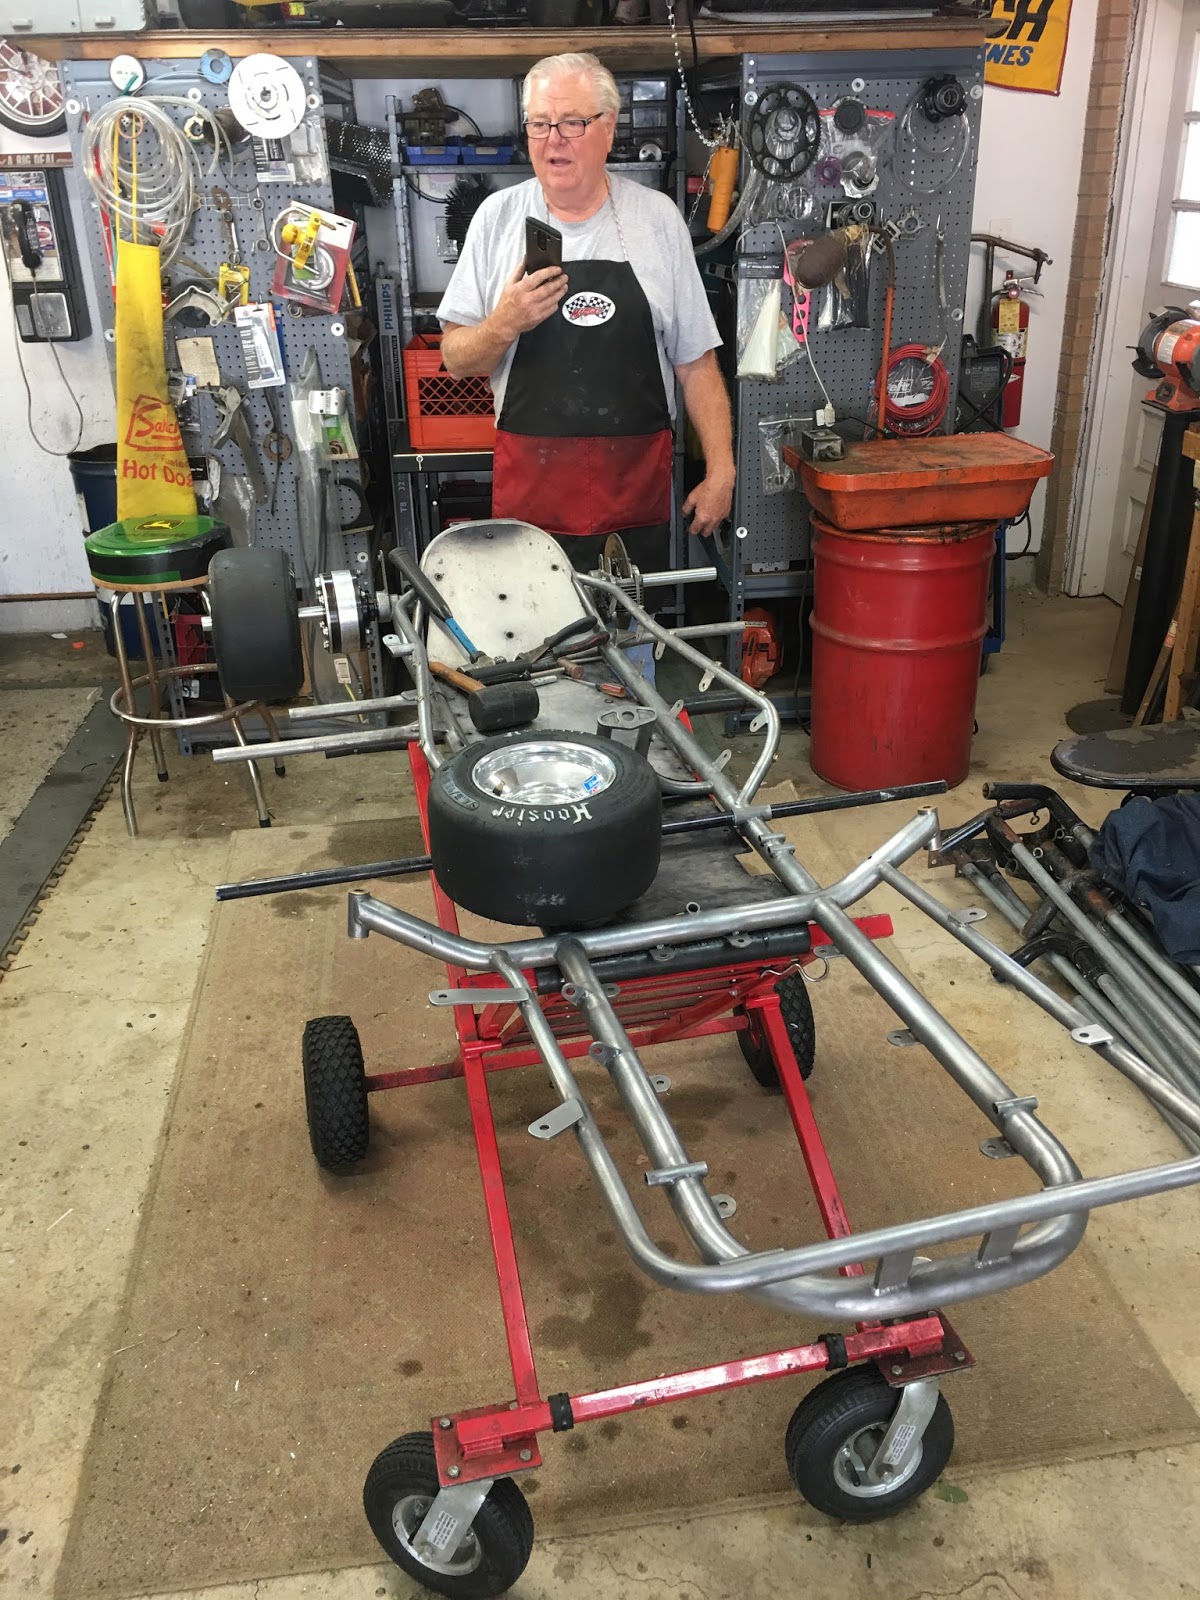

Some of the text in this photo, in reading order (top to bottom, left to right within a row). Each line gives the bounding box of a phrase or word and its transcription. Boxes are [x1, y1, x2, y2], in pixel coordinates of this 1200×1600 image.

[16, 154, 31, 165] BIG
[34, 153, 55, 164] DEAL
[382, 283, 394, 331] PHILIPS
[123, 459, 157, 480] Hot
[398, 481, 407, 514] T8 32
[491, 802, 593, 827] Hoosier
